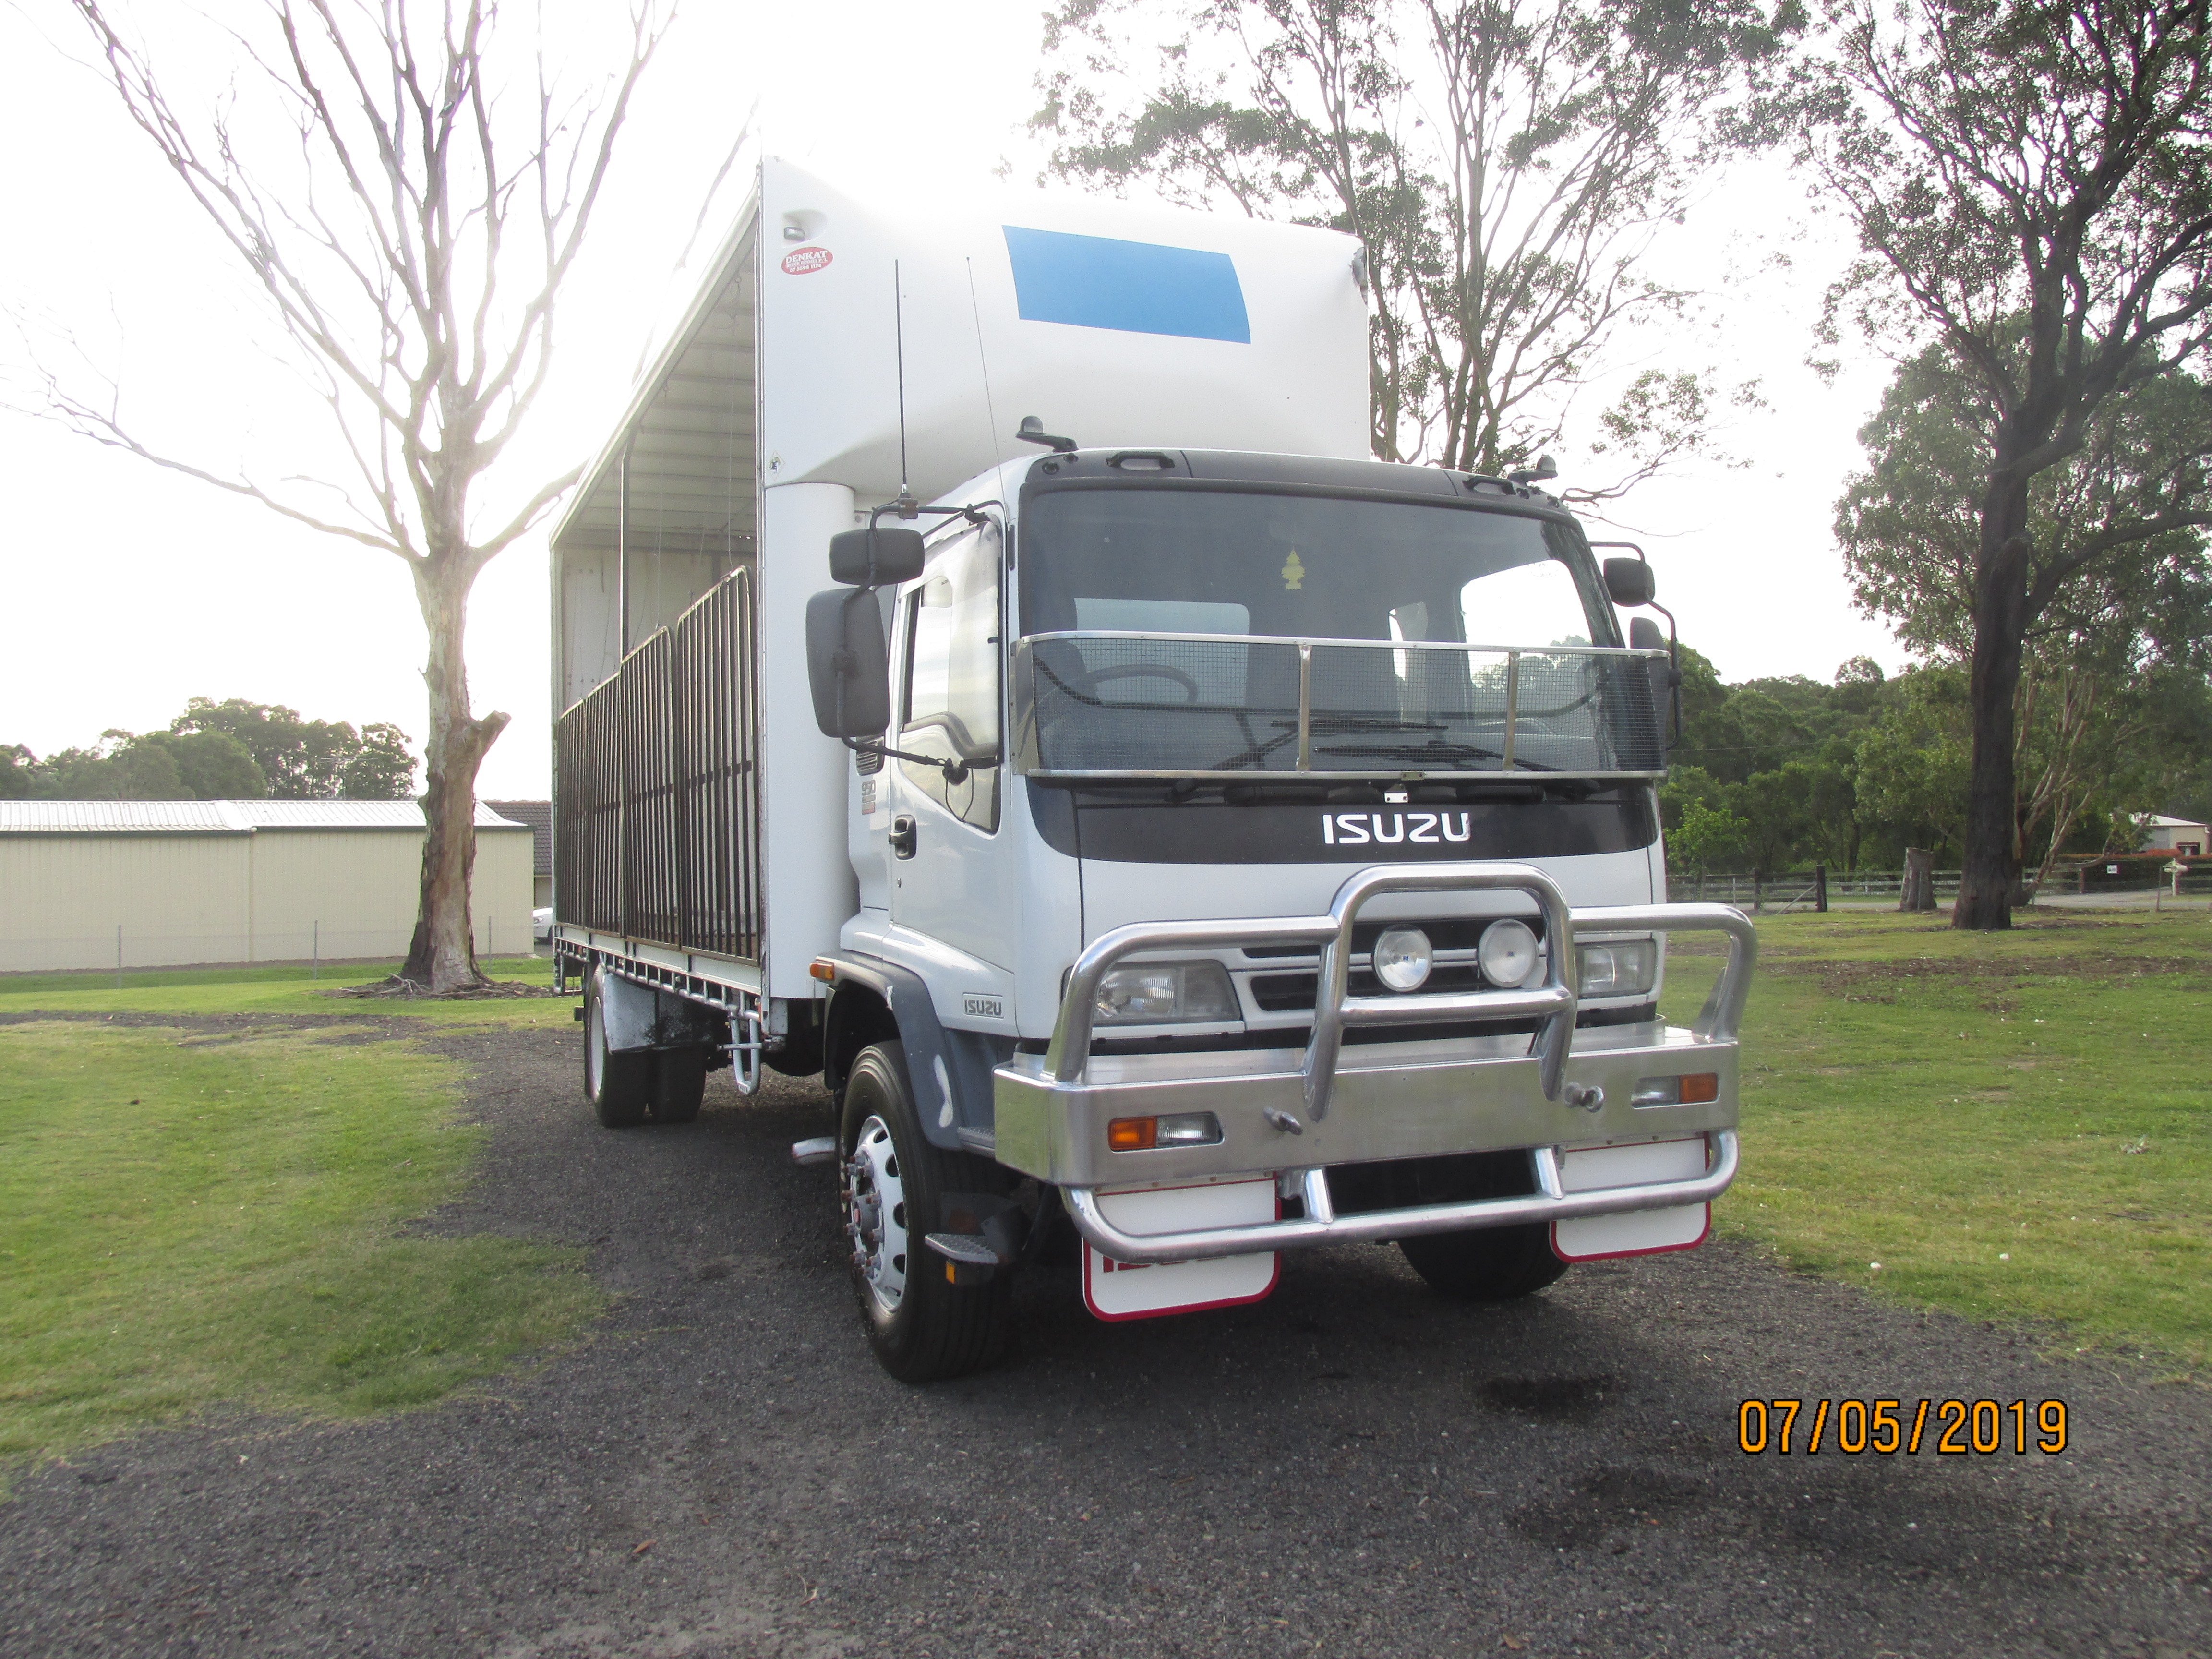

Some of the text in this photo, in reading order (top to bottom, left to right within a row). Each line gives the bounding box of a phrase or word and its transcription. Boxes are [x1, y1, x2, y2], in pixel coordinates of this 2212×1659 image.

[786, 250, 828, 264] DENKAT
[1322, 813, 1471, 844] ISUZU
[964, 999, 1001, 1015] ISUZU
